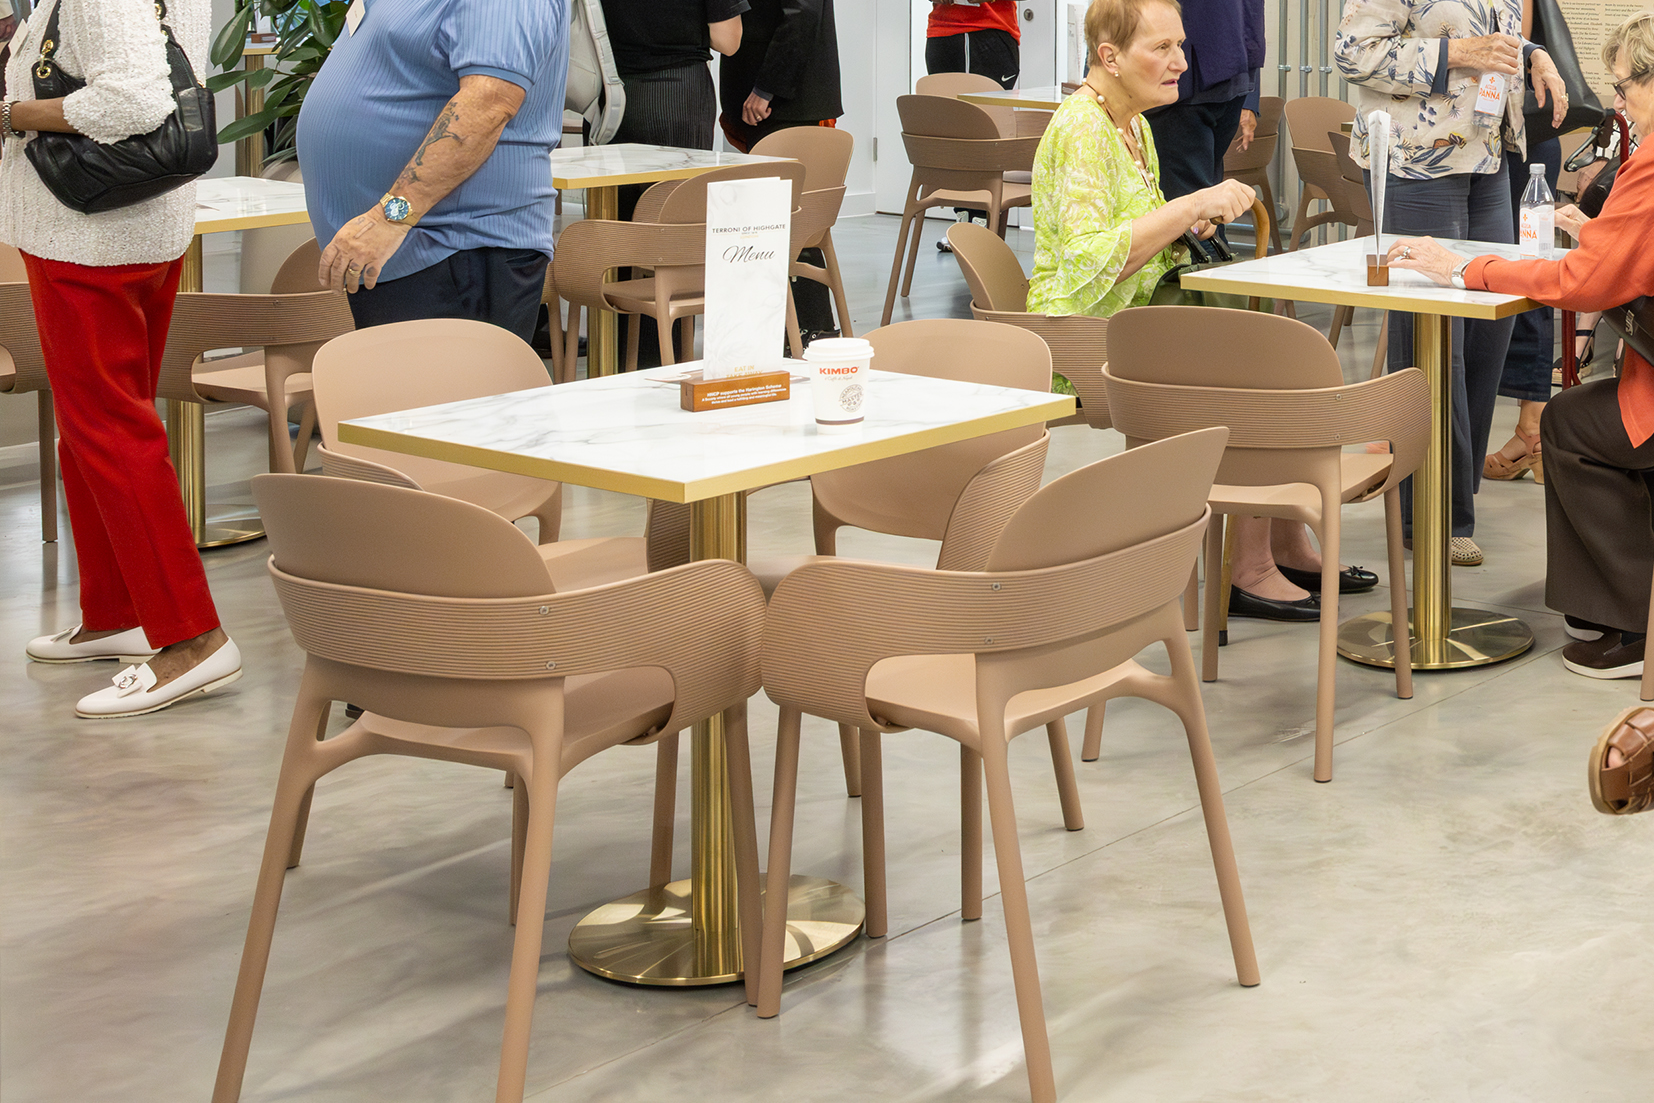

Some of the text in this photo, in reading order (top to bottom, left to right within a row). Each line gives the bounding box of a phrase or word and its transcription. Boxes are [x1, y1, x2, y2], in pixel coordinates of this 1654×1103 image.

[1479, 88, 1501, 100] PANNA
[722, 245, 776, 263] Menu
[819, 366, 858, 374] KIMBO
